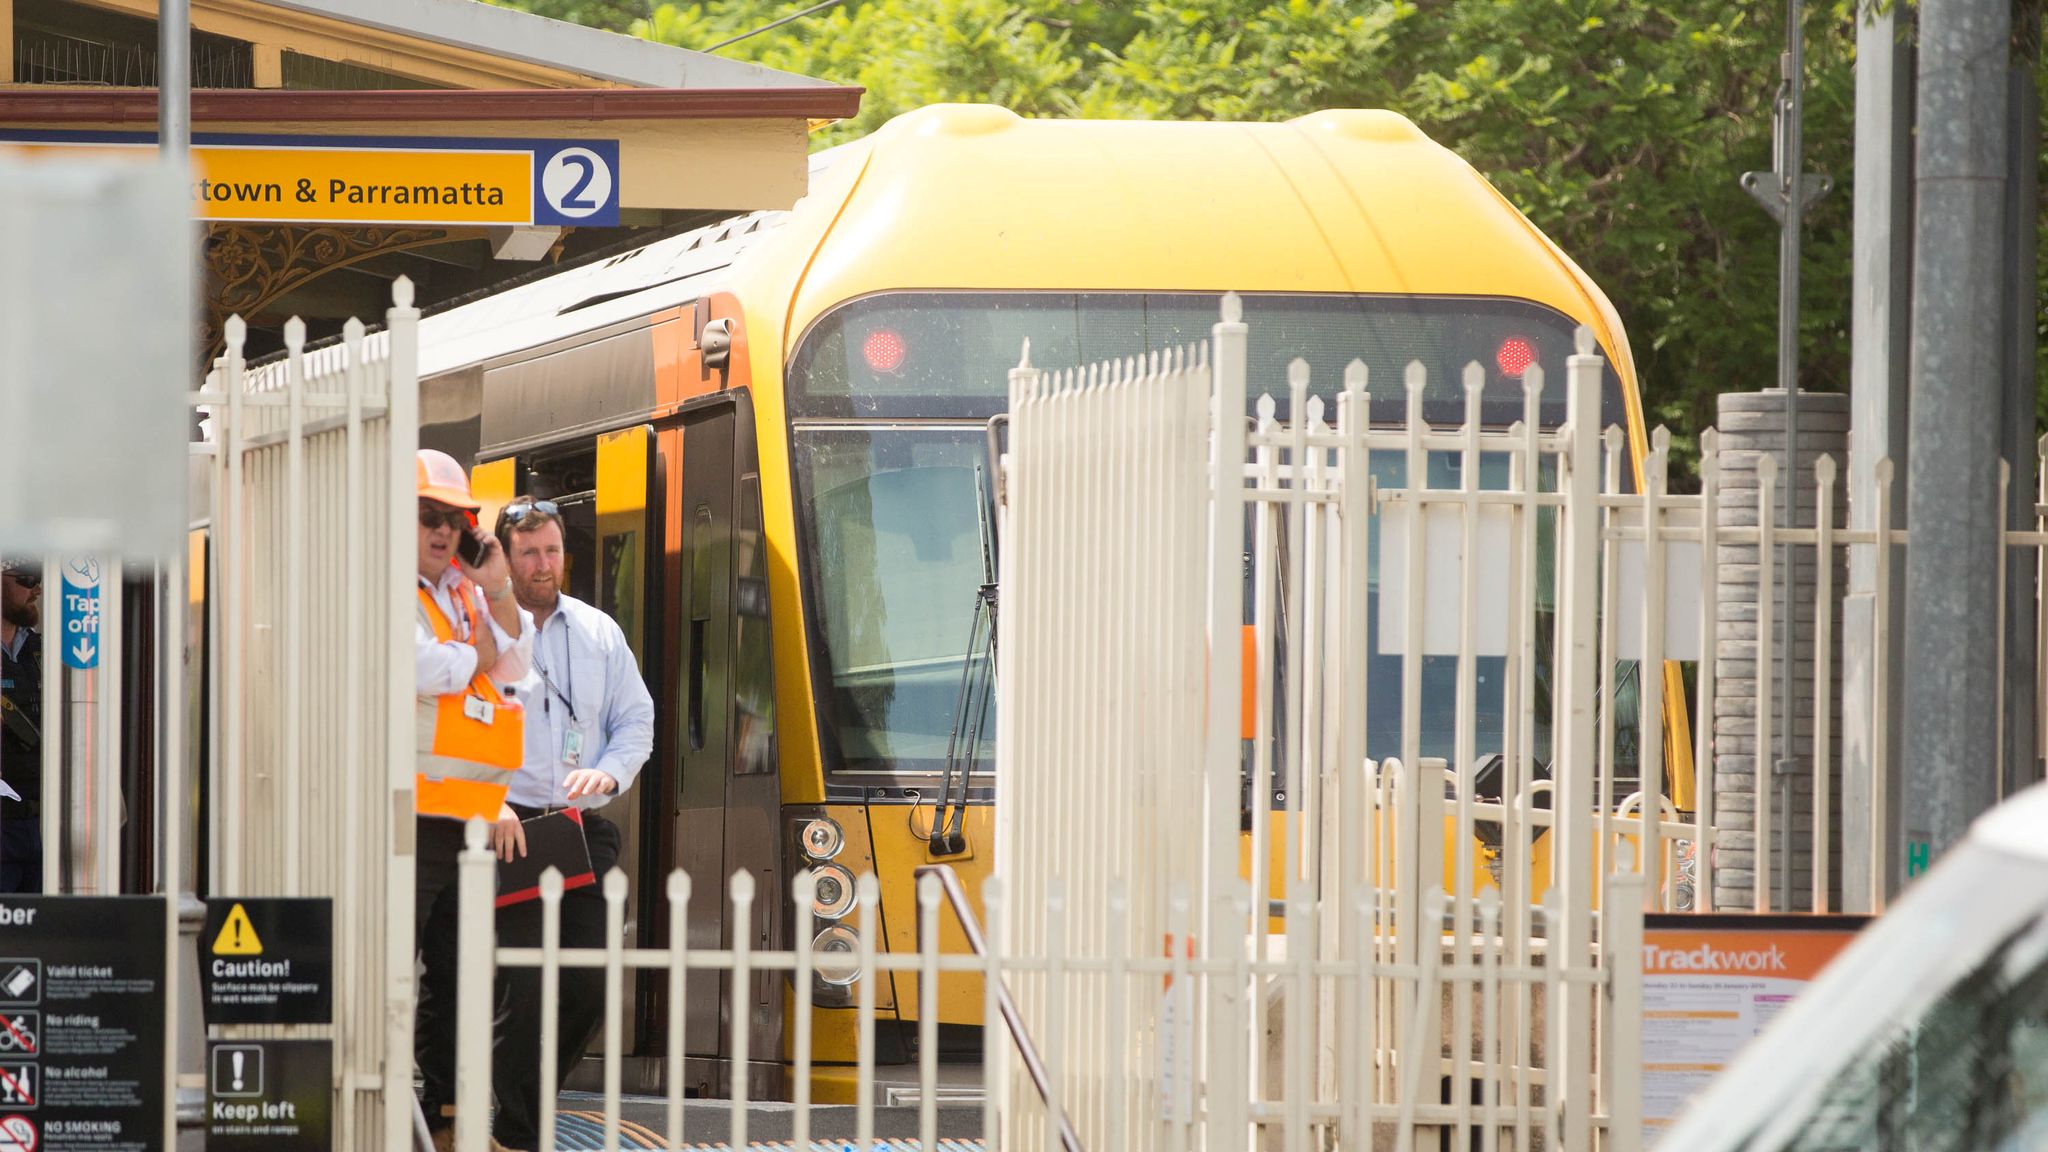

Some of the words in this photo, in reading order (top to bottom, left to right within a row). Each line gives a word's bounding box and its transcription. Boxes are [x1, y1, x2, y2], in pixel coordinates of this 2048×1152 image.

[560, 154, 597, 209] 2
[295, 179, 317, 203] &
[329, 178, 504, 206] Parramatta
[66, 594, 100, 615] Tap
[68, 615, 98, 633] off
[1643, 944, 1787, 970] Trackwork
[46, 965, 77, 978] Valid
[78, 965, 112, 977] ticket
[212, 959, 290, 977] Caution!
[46, 1014, 63, 1026] No
[65, 1014, 99, 1028] riding
[45, 1066, 62, 1078] No
[64, 1066, 107, 1078] alcohol
[213, 1101, 259, 1123] Keep
[262, 1101, 296, 1119] left
[44, 1121, 63, 1133] NO
[64, 1121, 121, 1134] SMOKING
